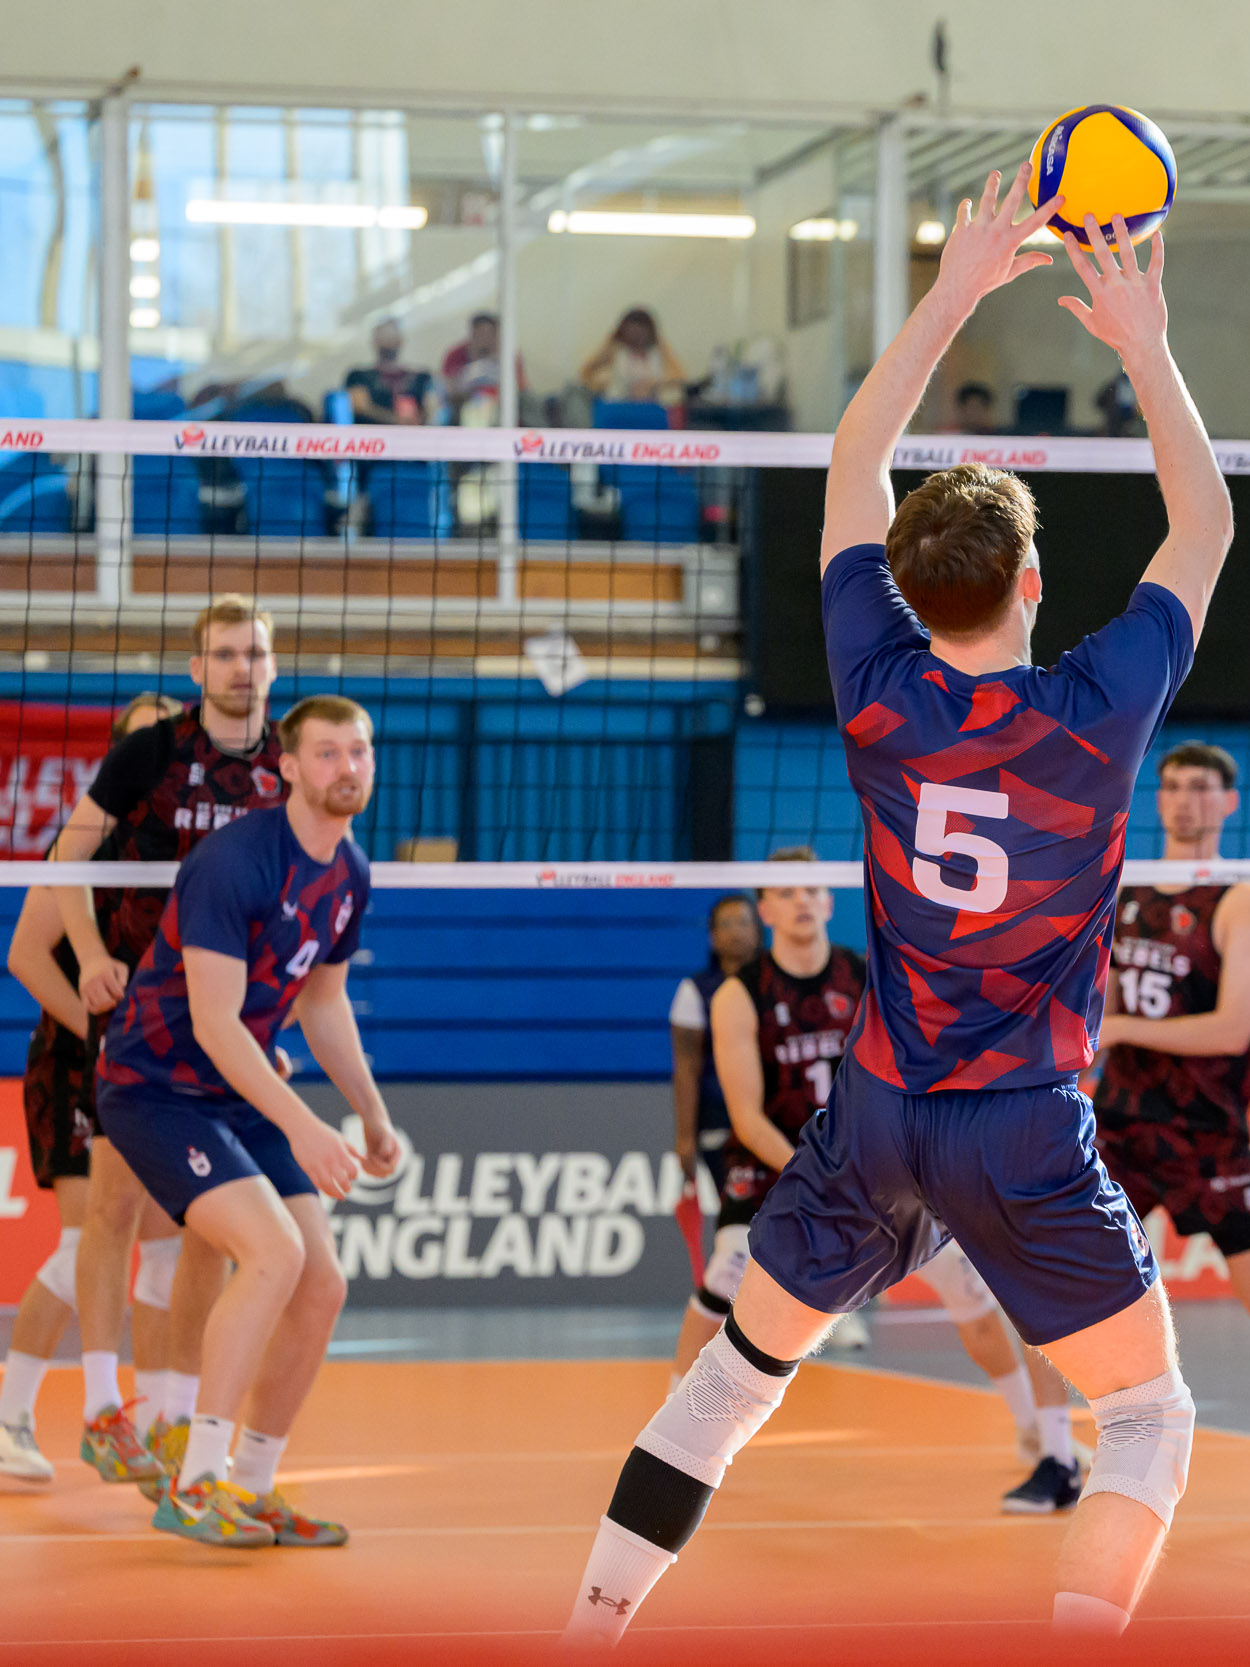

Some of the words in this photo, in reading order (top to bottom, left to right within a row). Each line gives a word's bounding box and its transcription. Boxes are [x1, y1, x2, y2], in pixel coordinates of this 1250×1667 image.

[295, 437, 385, 456] ENGLAND
[631, 441, 720, 460] ENGLAND
[911, 782, 1009, 913] 5
[1119, 967, 1172, 1019] 15
